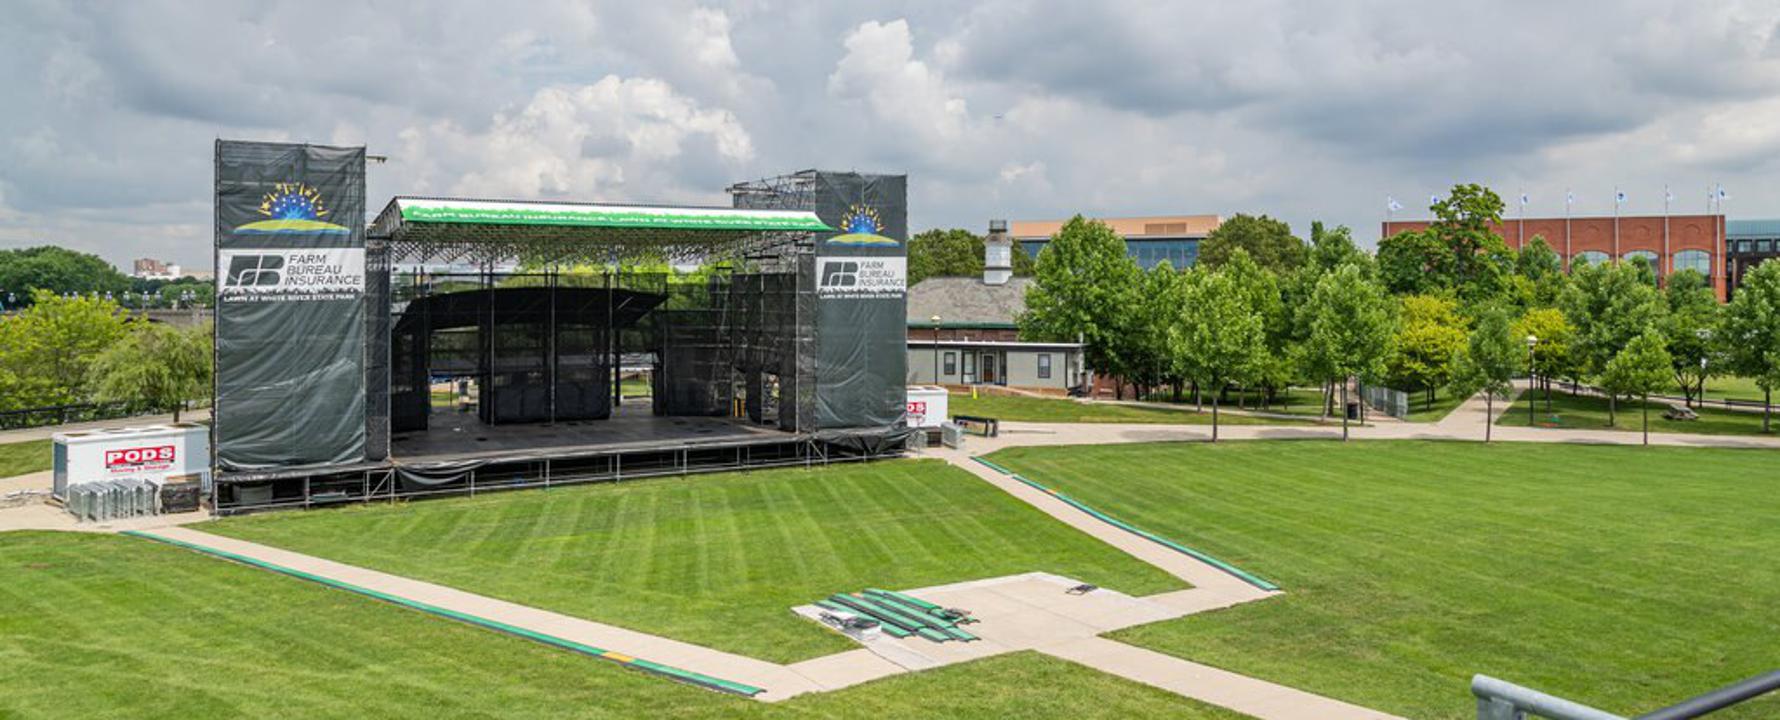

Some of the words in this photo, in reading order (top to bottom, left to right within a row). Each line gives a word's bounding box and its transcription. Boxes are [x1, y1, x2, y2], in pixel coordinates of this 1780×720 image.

[289, 254, 327, 264] FARM
[286, 264, 343, 275] BUREAU
[860, 261, 884, 269] FARM
[859, 270, 895, 278] BUREAU
[284, 275, 362, 286] INSURANCE
[858, 278, 905, 287] INSURANCE
[107, 447, 173, 464] PODS
